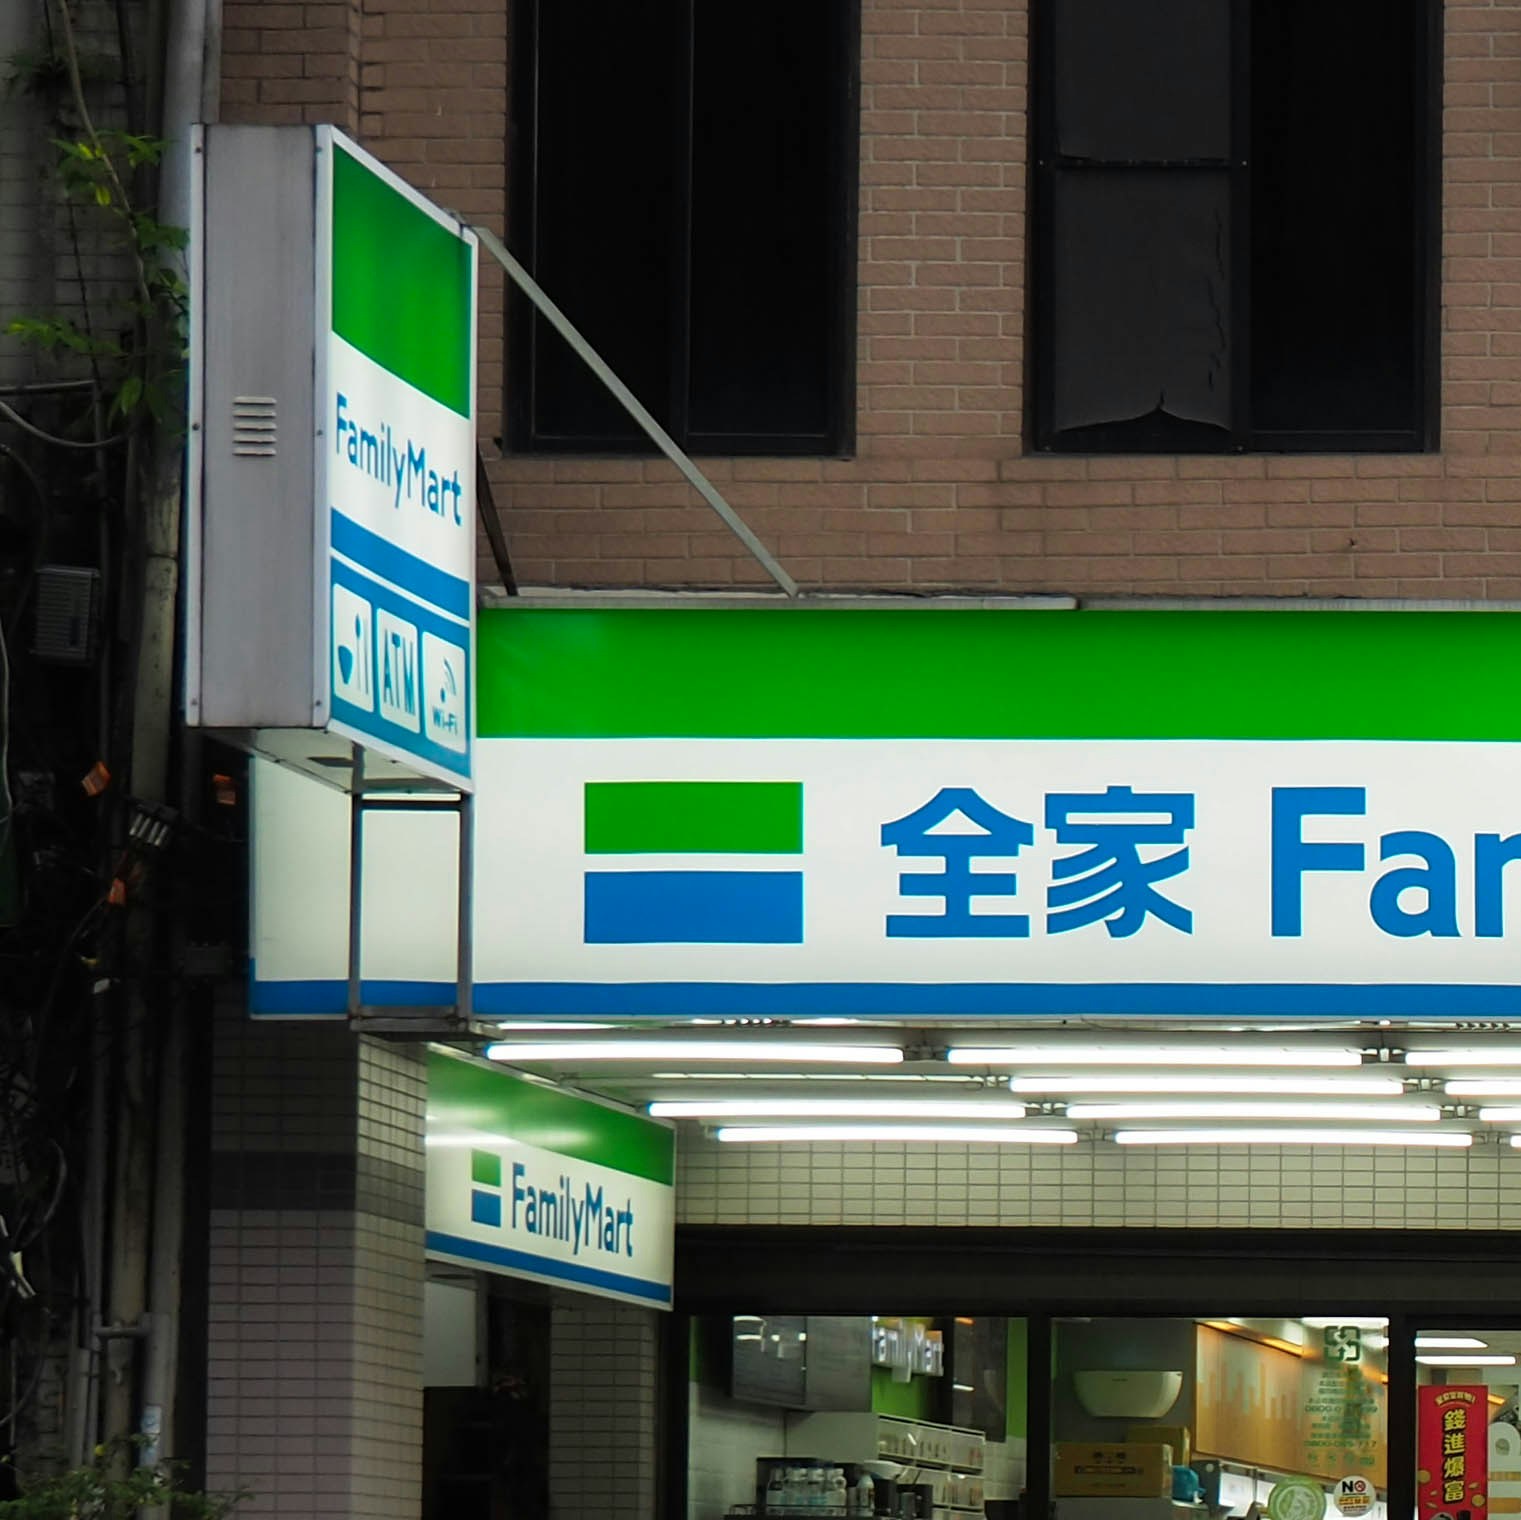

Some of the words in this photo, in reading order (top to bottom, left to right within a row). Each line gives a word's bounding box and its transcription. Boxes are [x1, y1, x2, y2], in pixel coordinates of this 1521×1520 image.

[336, 391, 463, 528] FamilyMart
[383, 626, 417, 717] ATM
[431, 706, 459, 736] Wi-Fi
[880, 785, 1196, 940] 全家
[511, 1162, 634, 1258] FamilyMart
